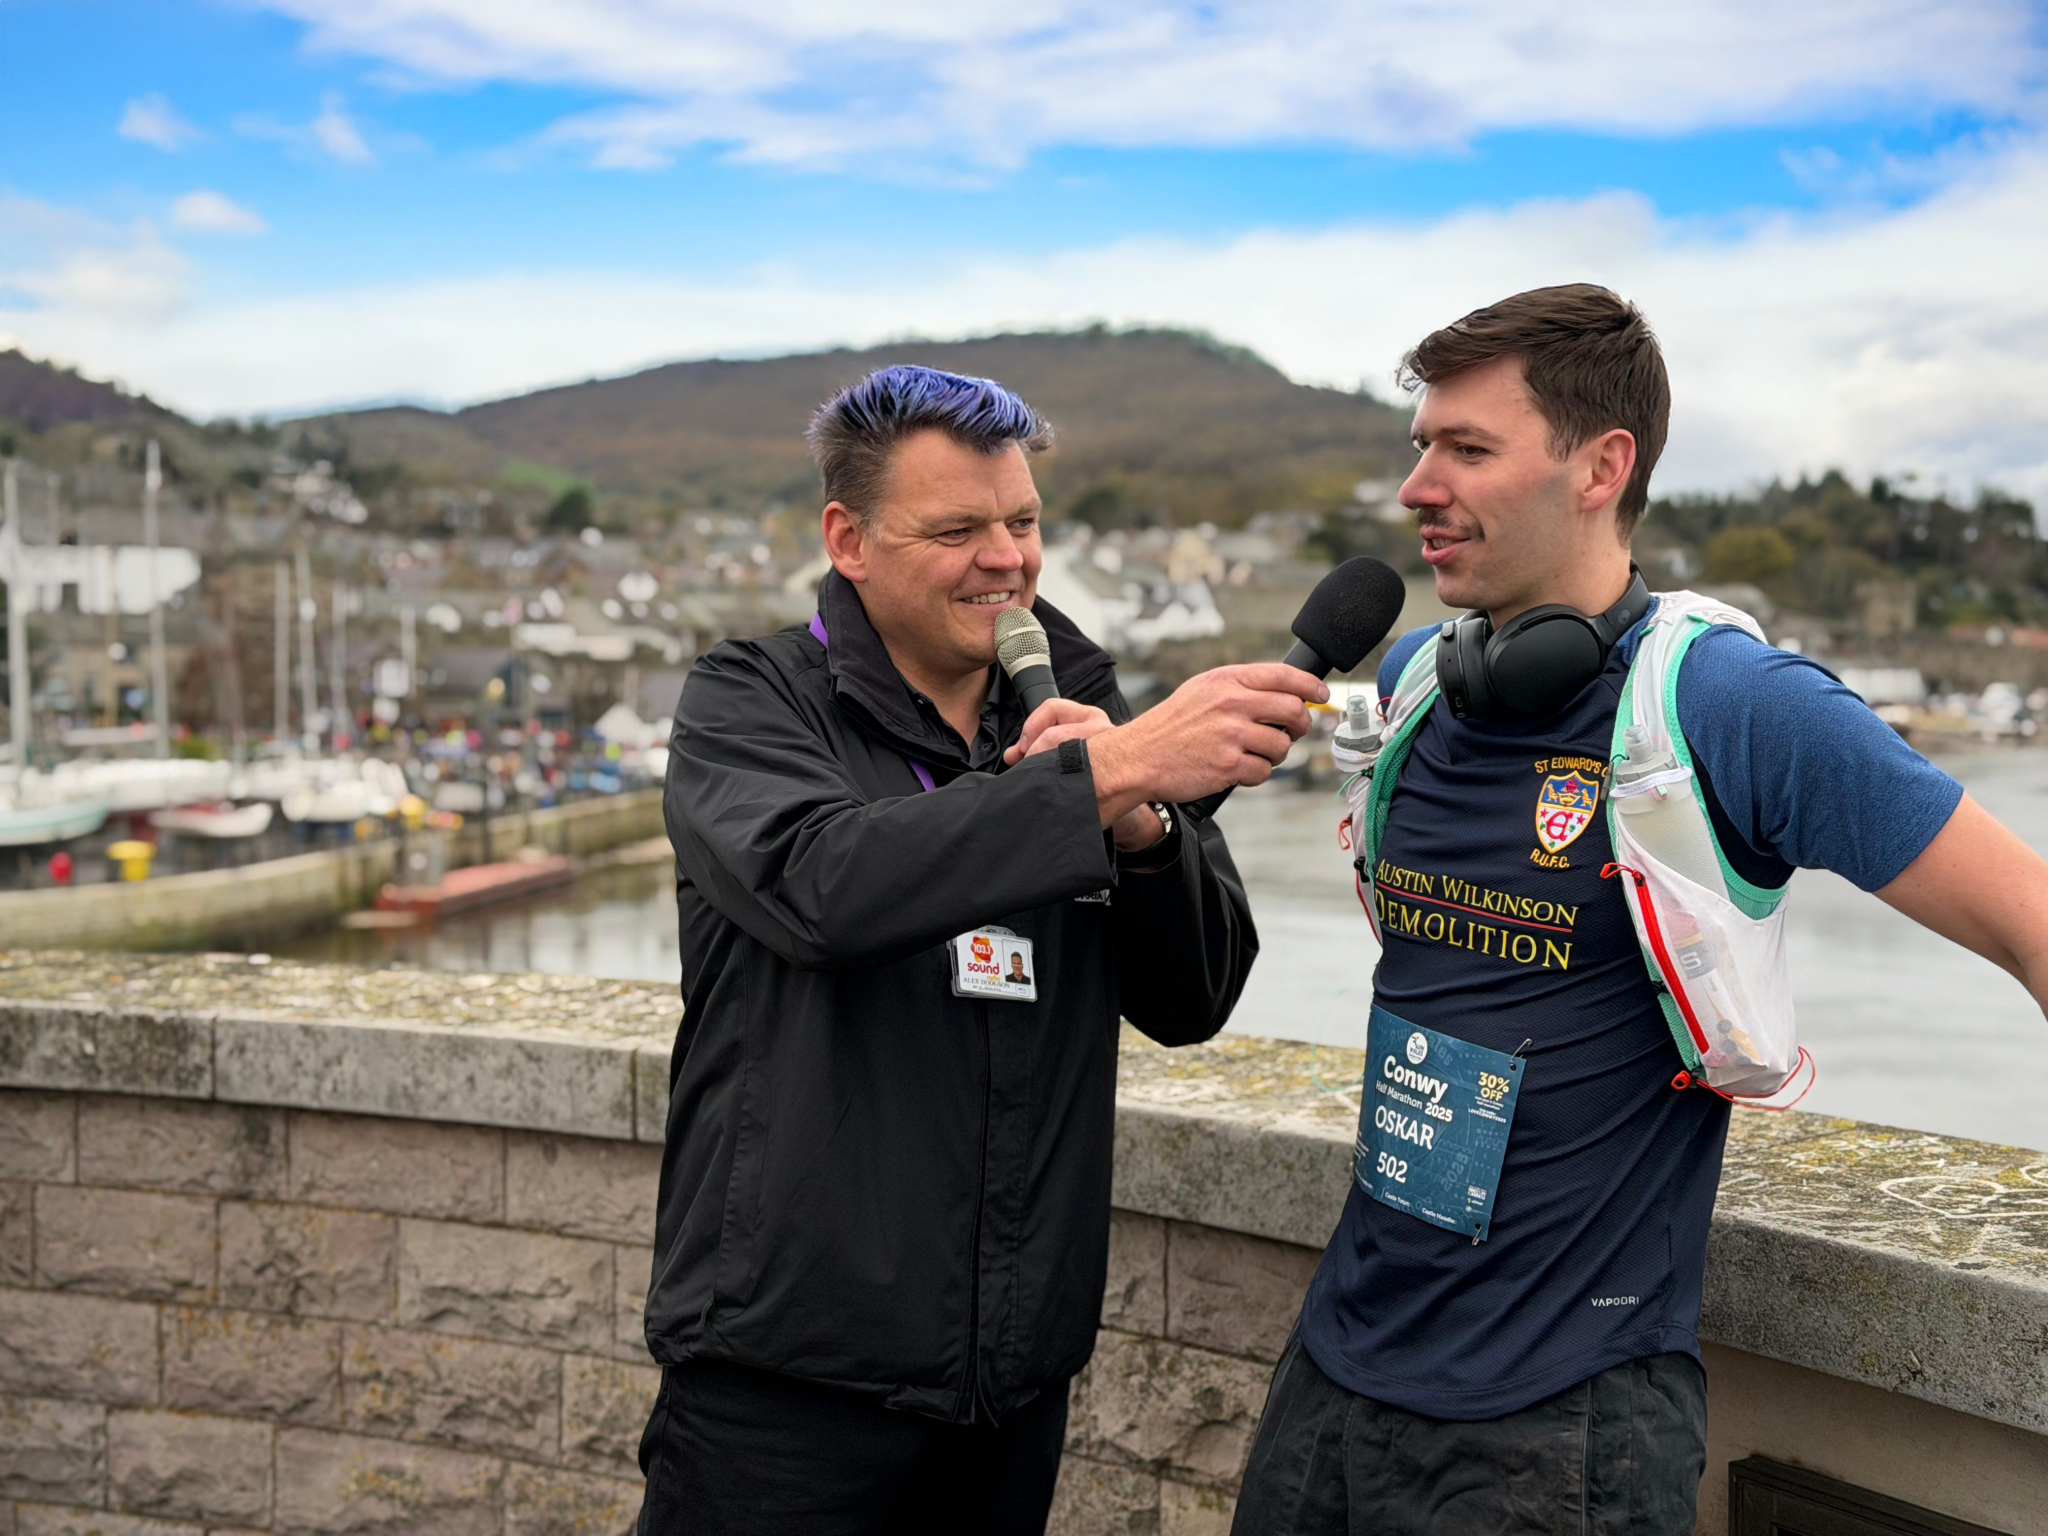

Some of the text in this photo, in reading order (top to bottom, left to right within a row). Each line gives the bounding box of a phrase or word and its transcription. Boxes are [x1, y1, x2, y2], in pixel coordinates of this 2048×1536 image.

[1534, 759, 1550, 774] ST
[1550, 756, 1602, 774] EDWARD'S
[1529, 848, 1570, 869] R.U.F.C.
[1375, 858, 1579, 927] AUSTIN WILKINSON
[1374, 887, 1573, 970] DEMOLITION
[973, 943, 991, 955] 103.1
[967, 962, 1000, 975] sound
[980, 979, 1010, 988] HODGSON
[1383, 1055, 1449, 1104] Conwy
[1478, 1071, 1511, 1093] 30%
[1375, 1080, 1388, 1094] Half
[1387, 1085, 1423, 1110] Marathon
[1424, 1102, 1454, 1123] 2025
[1480, 1087, 1504, 1102] OFF
[1375, 1105, 1434, 1151] OSKAR
[1376, 1151, 1408, 1184] 502
[1591, 1296, 1640, 1307] VAPODRI
